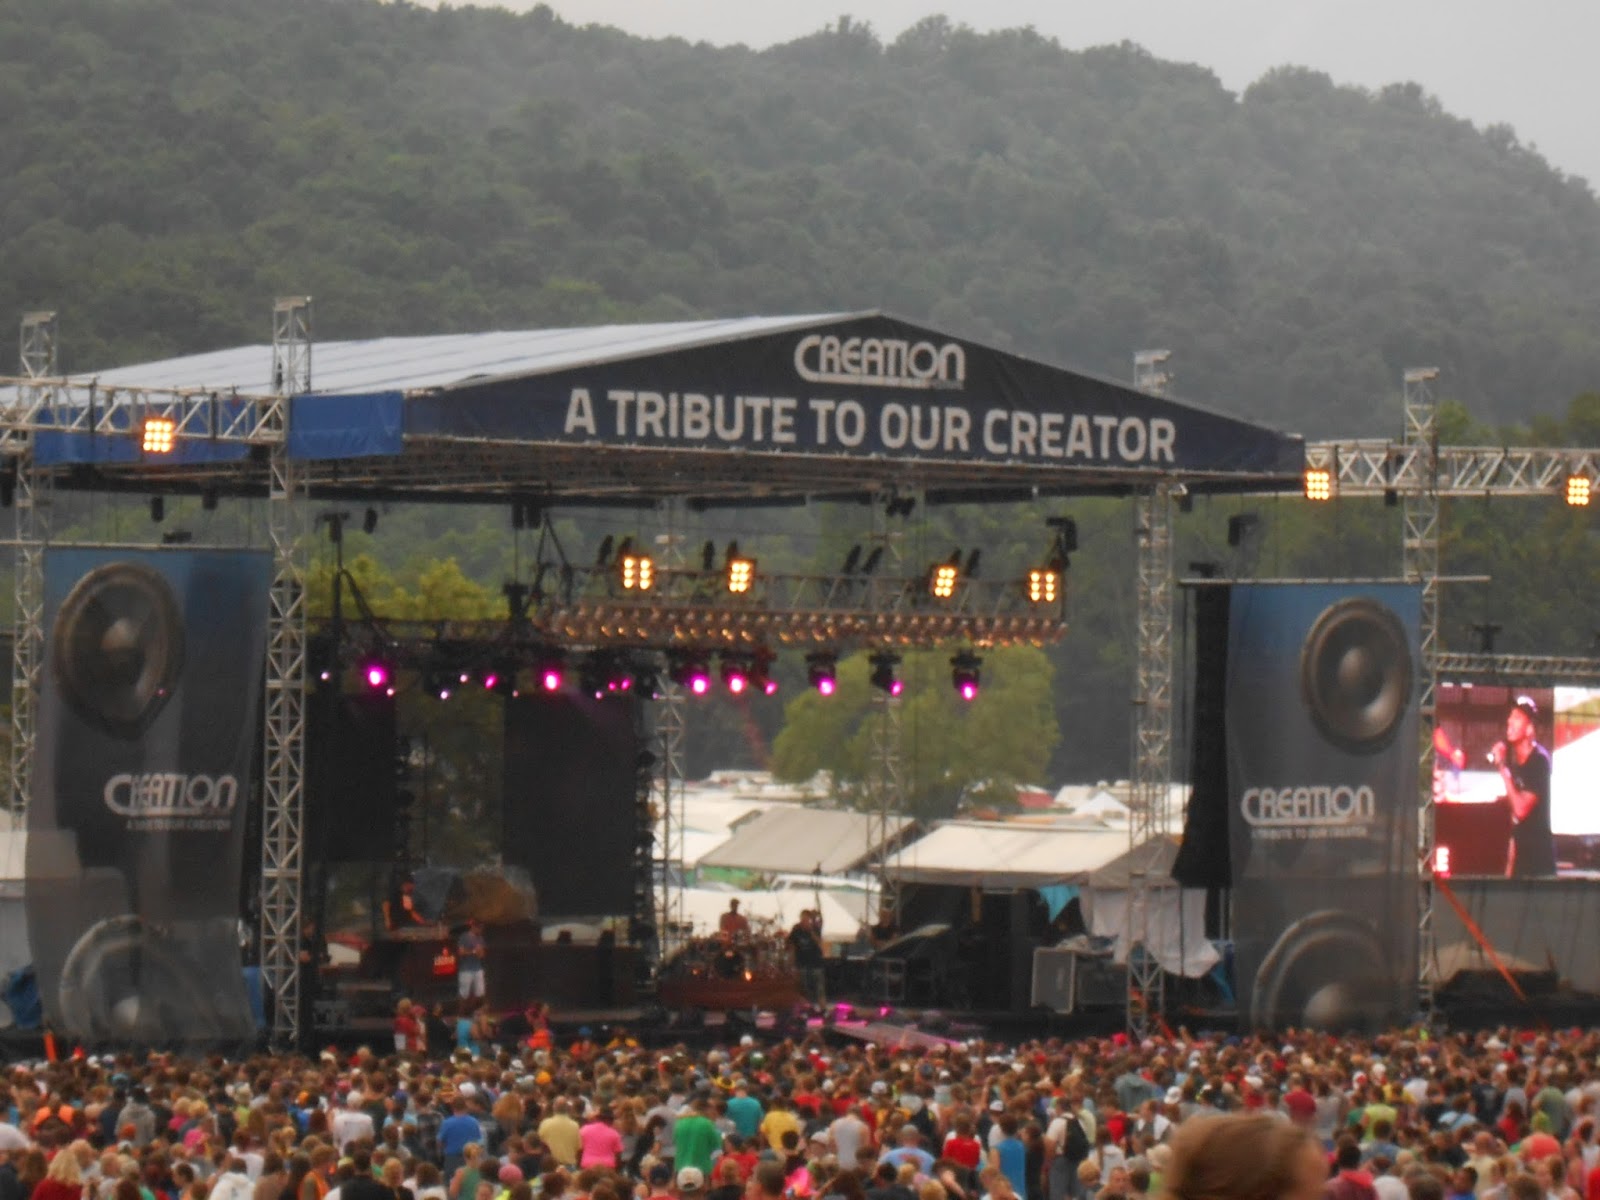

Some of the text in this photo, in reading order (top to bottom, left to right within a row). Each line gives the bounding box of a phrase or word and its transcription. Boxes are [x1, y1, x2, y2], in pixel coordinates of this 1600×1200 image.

[795, 335, 966, 388] CREATION
[564, 388, 1176, 462] A TRIBUTE TO OUR CREATOR
[1241, 785, 1375, 826] CREATION
